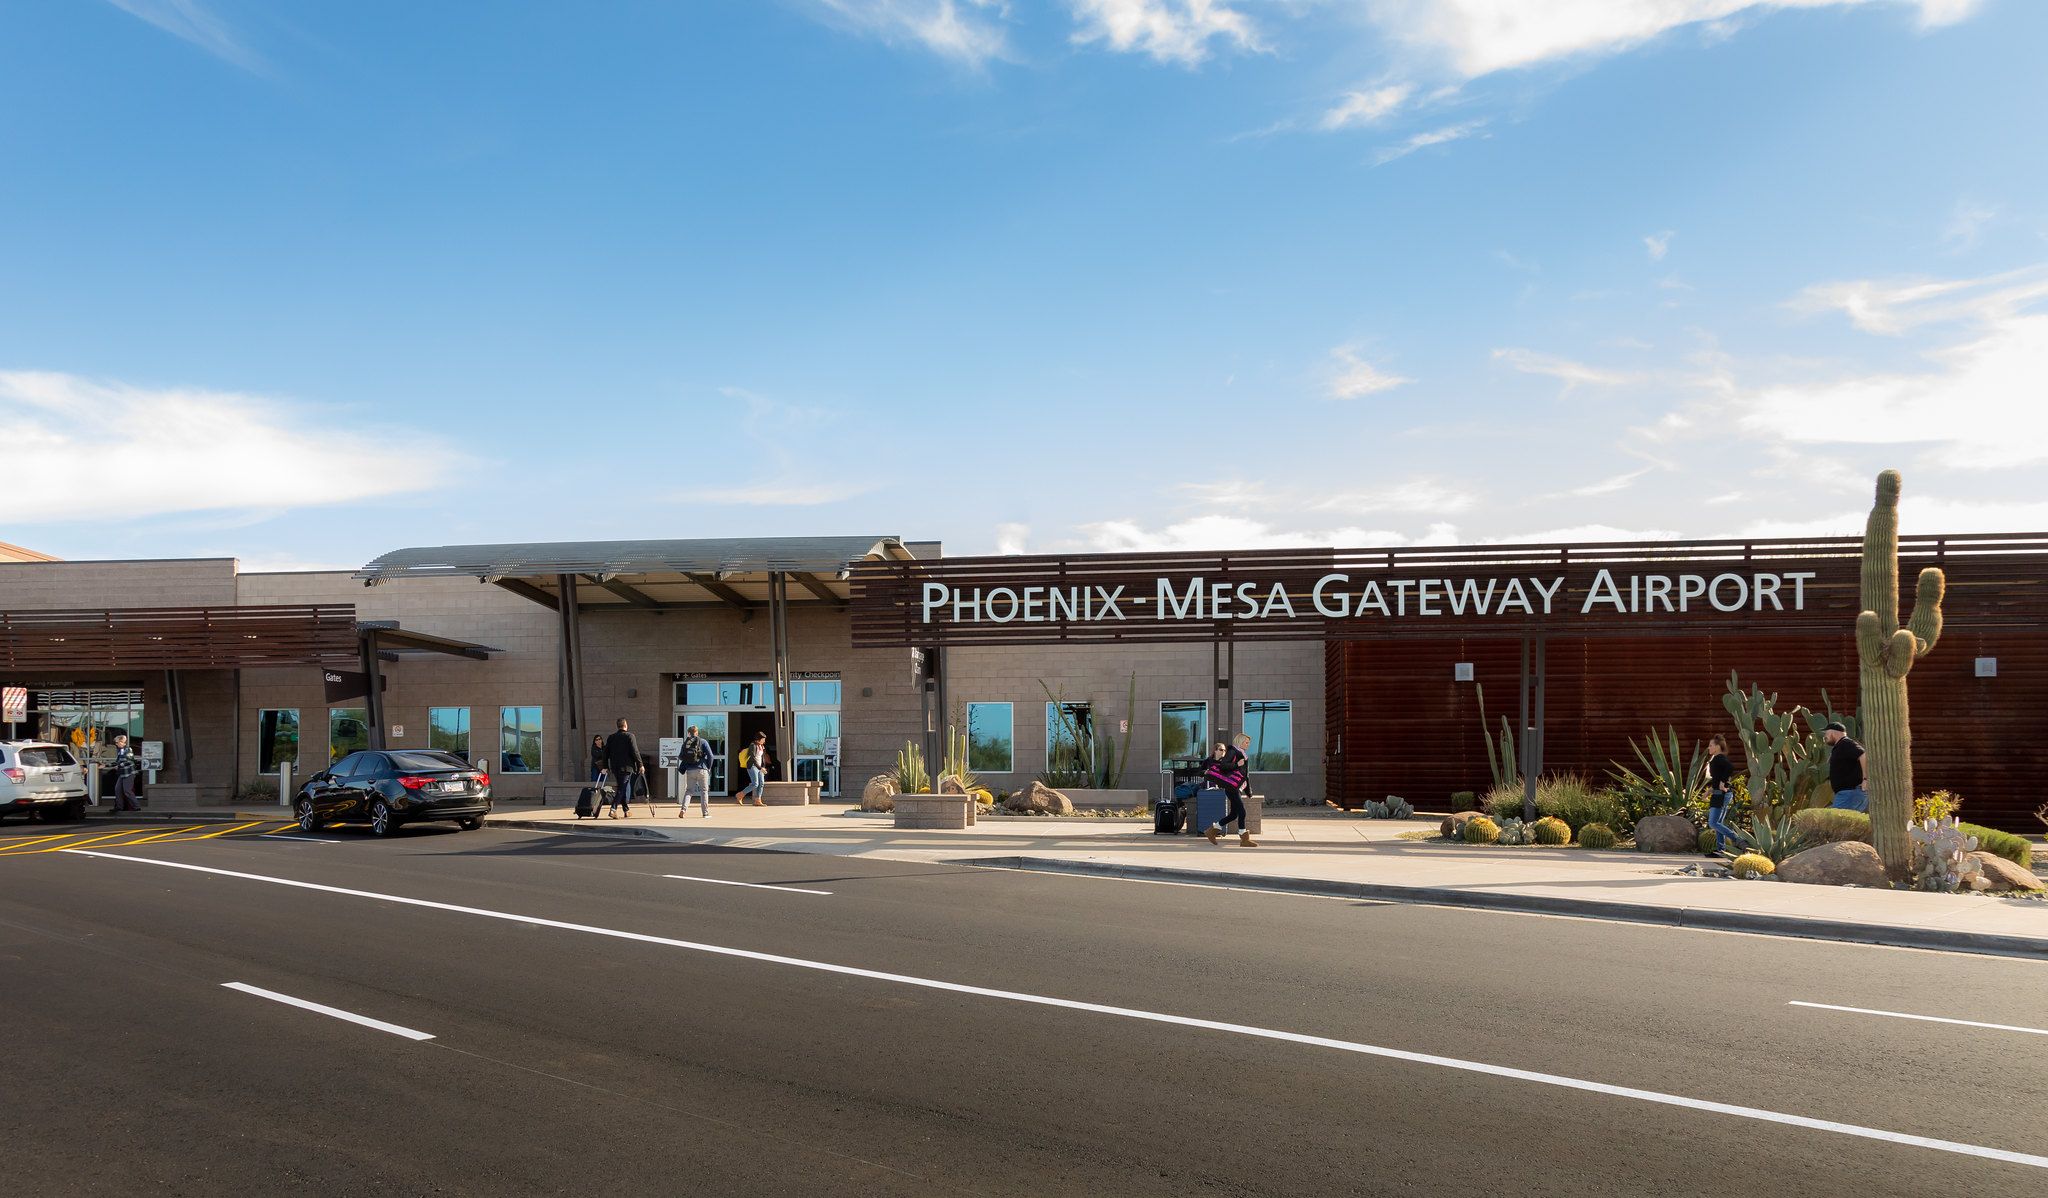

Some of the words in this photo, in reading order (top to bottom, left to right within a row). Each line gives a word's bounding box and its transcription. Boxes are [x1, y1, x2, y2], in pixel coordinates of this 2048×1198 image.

[1312, 573, 1565, 618] GATEWAY
[1581, 568, 1817, 614] AIRPORT
[325, 672, 342, 683] Gates
